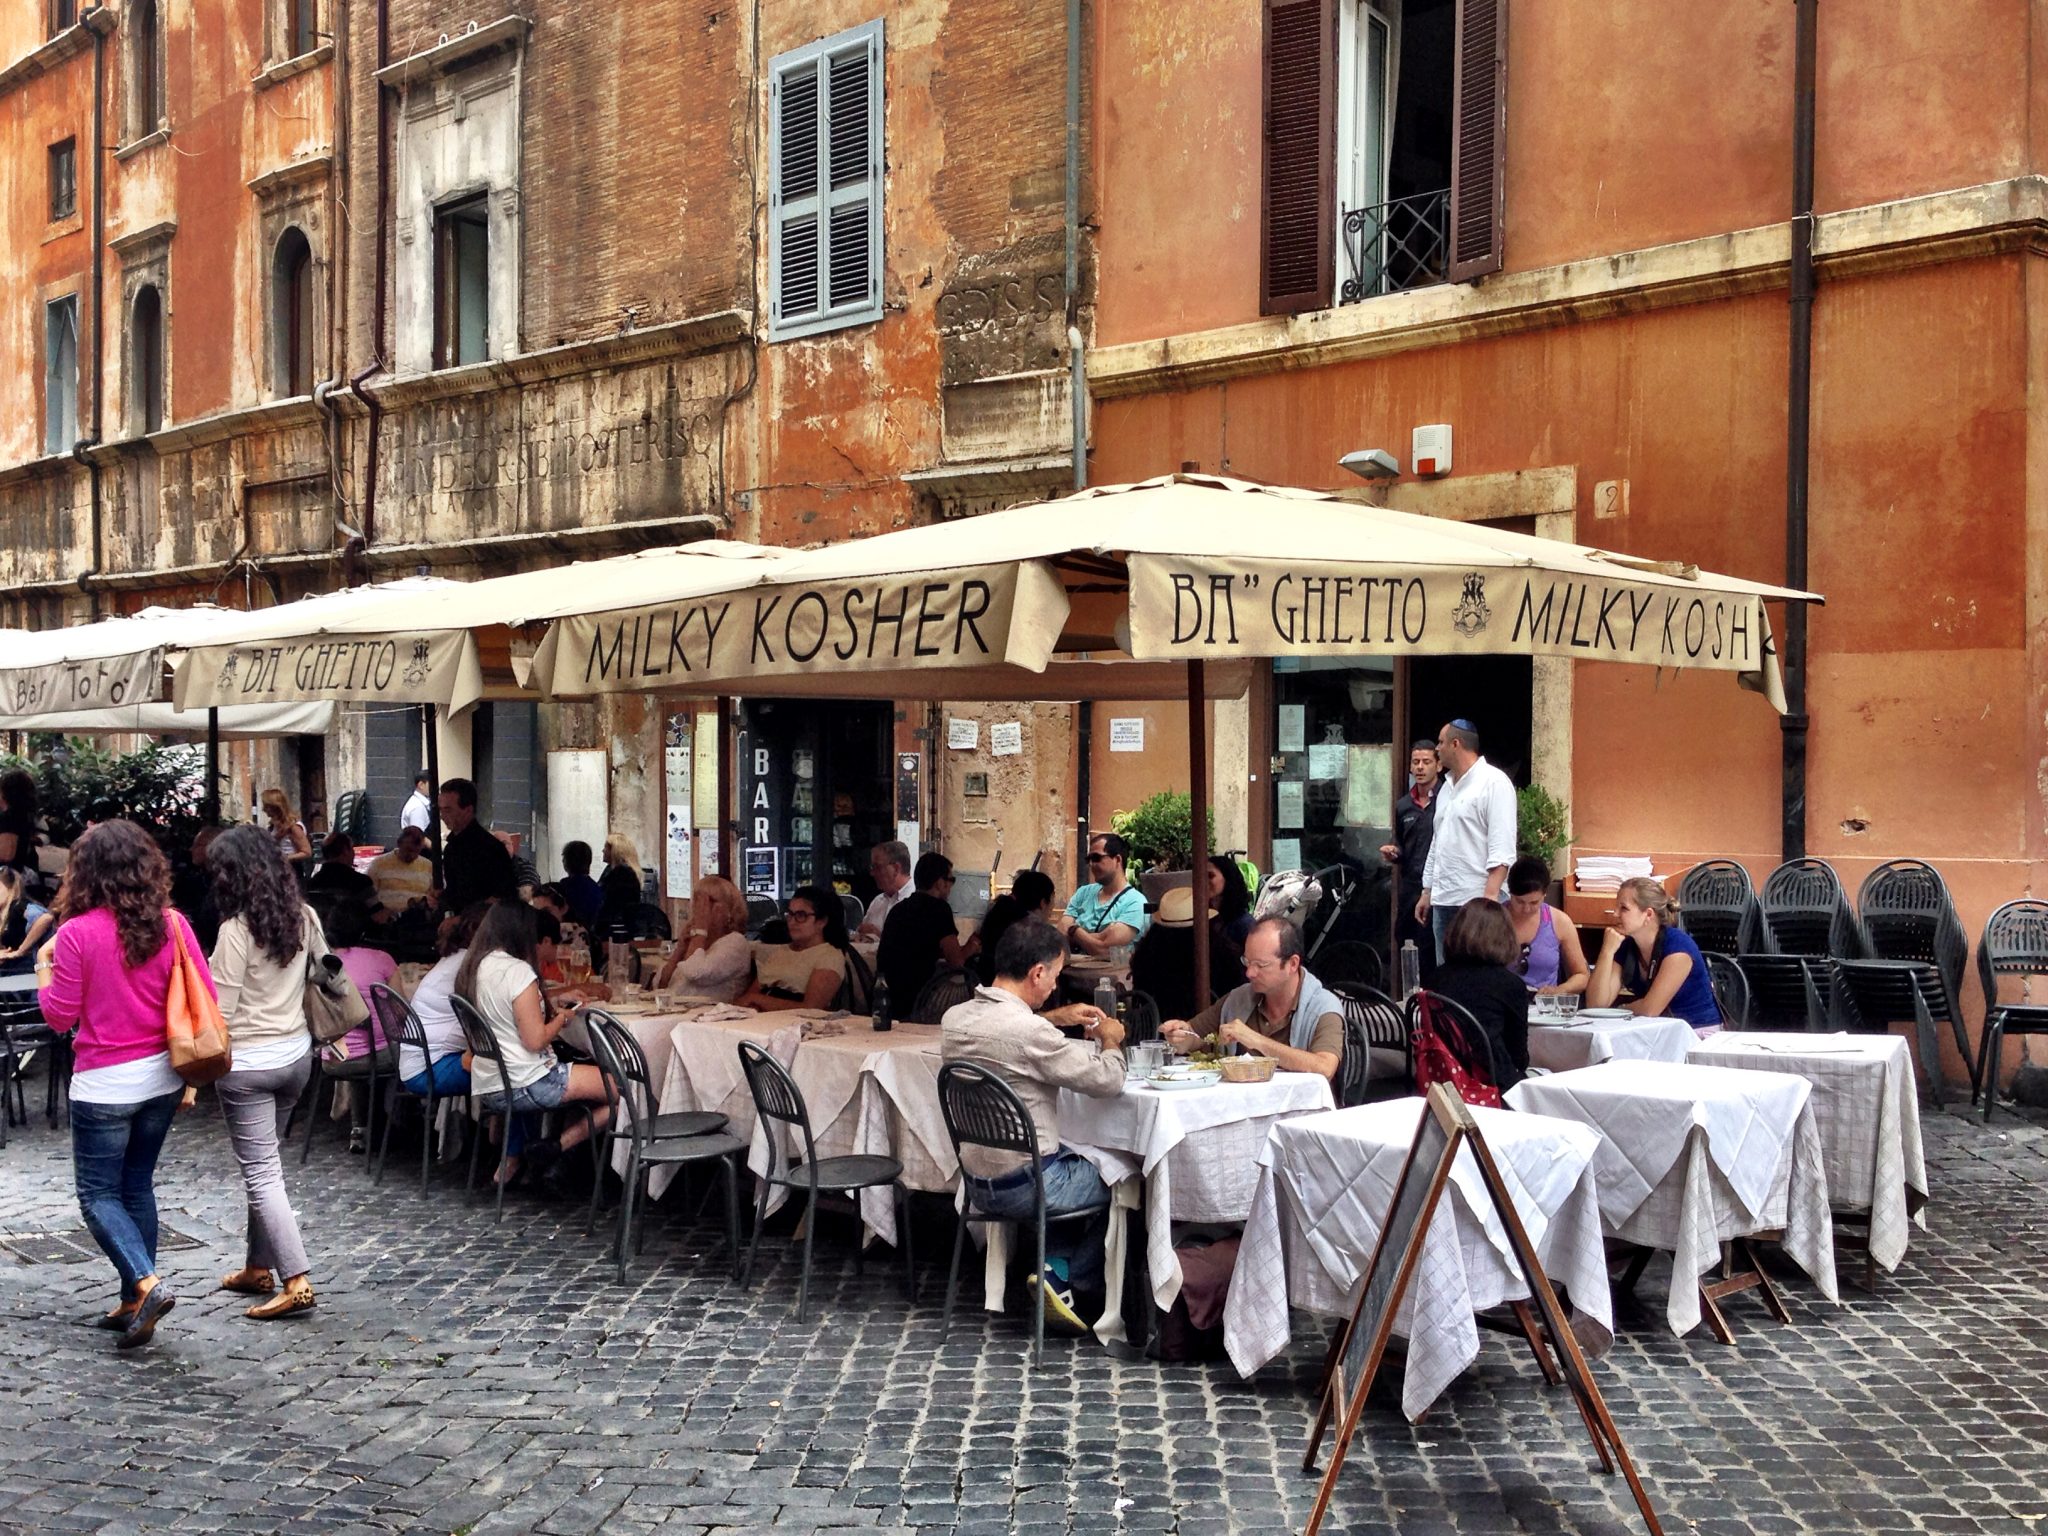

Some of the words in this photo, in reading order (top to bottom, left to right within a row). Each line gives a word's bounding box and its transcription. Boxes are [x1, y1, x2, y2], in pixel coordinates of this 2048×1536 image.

[1605, 485, 1619, 513] 2
[585, 601, 730, 683] MILKY
[750, 579, 992, 665] KOSHER
[1271, 572, 1427, 645] GHETTO
[1511, 578, 1654, 652] MILKY
[1661, 596, 1776, 660] KOSH
[16, 679, 47, 712] Bar
[295, 639, 397, 692] GHETTO
[753, 748, 770, 844] BAR
